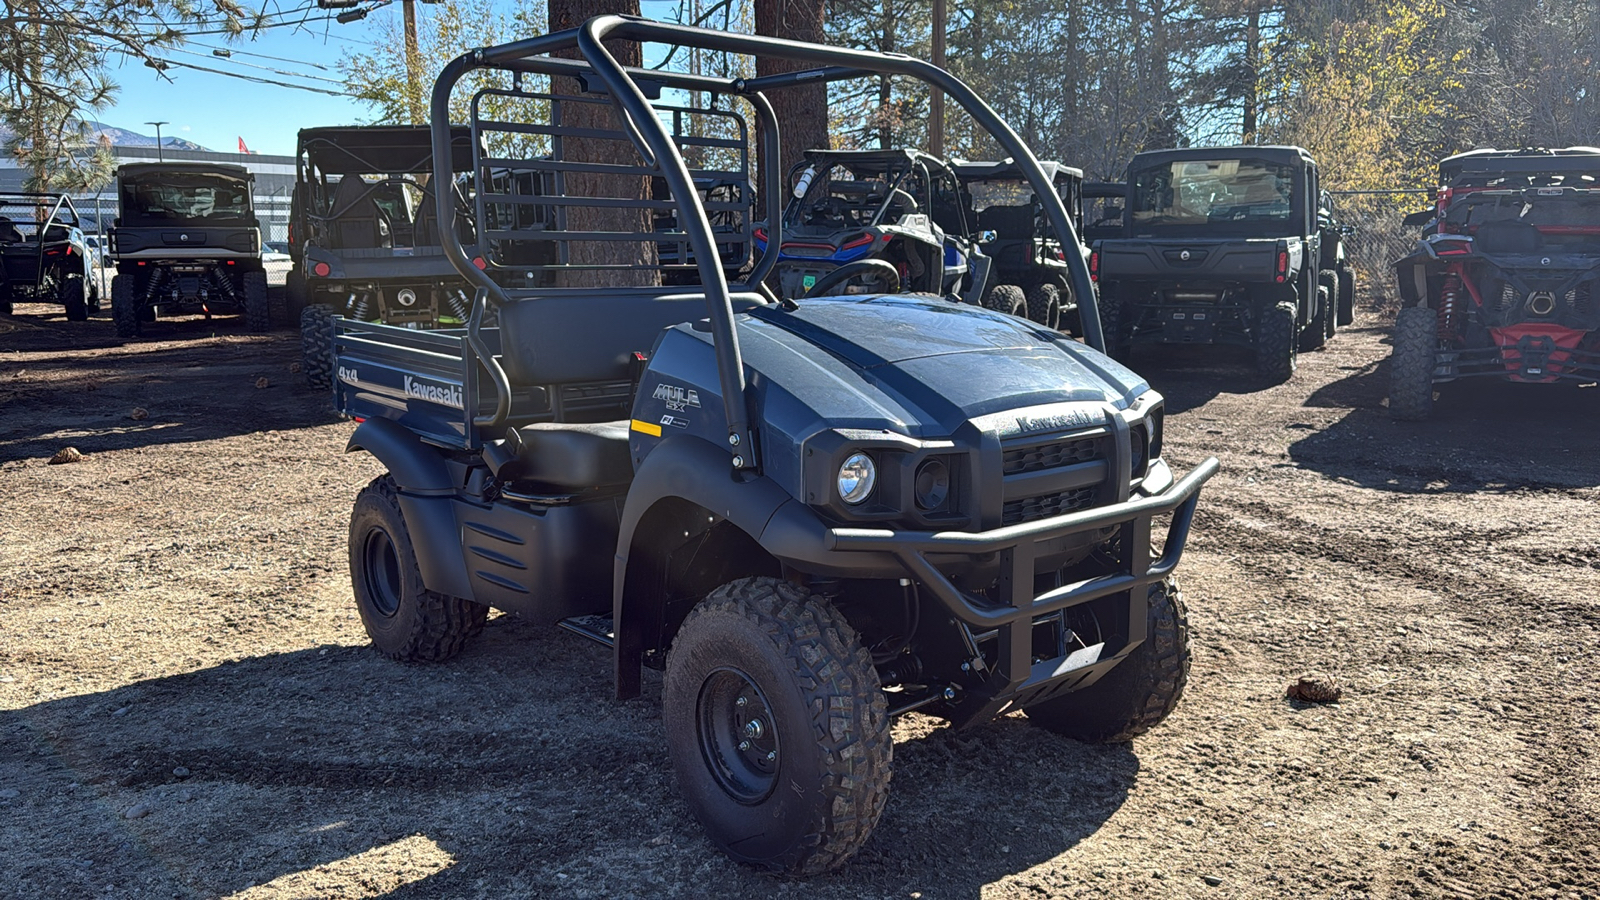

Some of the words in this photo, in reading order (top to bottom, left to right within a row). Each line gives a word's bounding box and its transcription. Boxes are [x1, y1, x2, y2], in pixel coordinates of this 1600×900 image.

[338, 366, 359, 383] 4x4
[403, 375, 463, 407] Kawasaki
[652, 383, 702, 408] MULE
[666, 401, 685, 413] SX
[1016, 409, 1093, 433] Kawasaki
